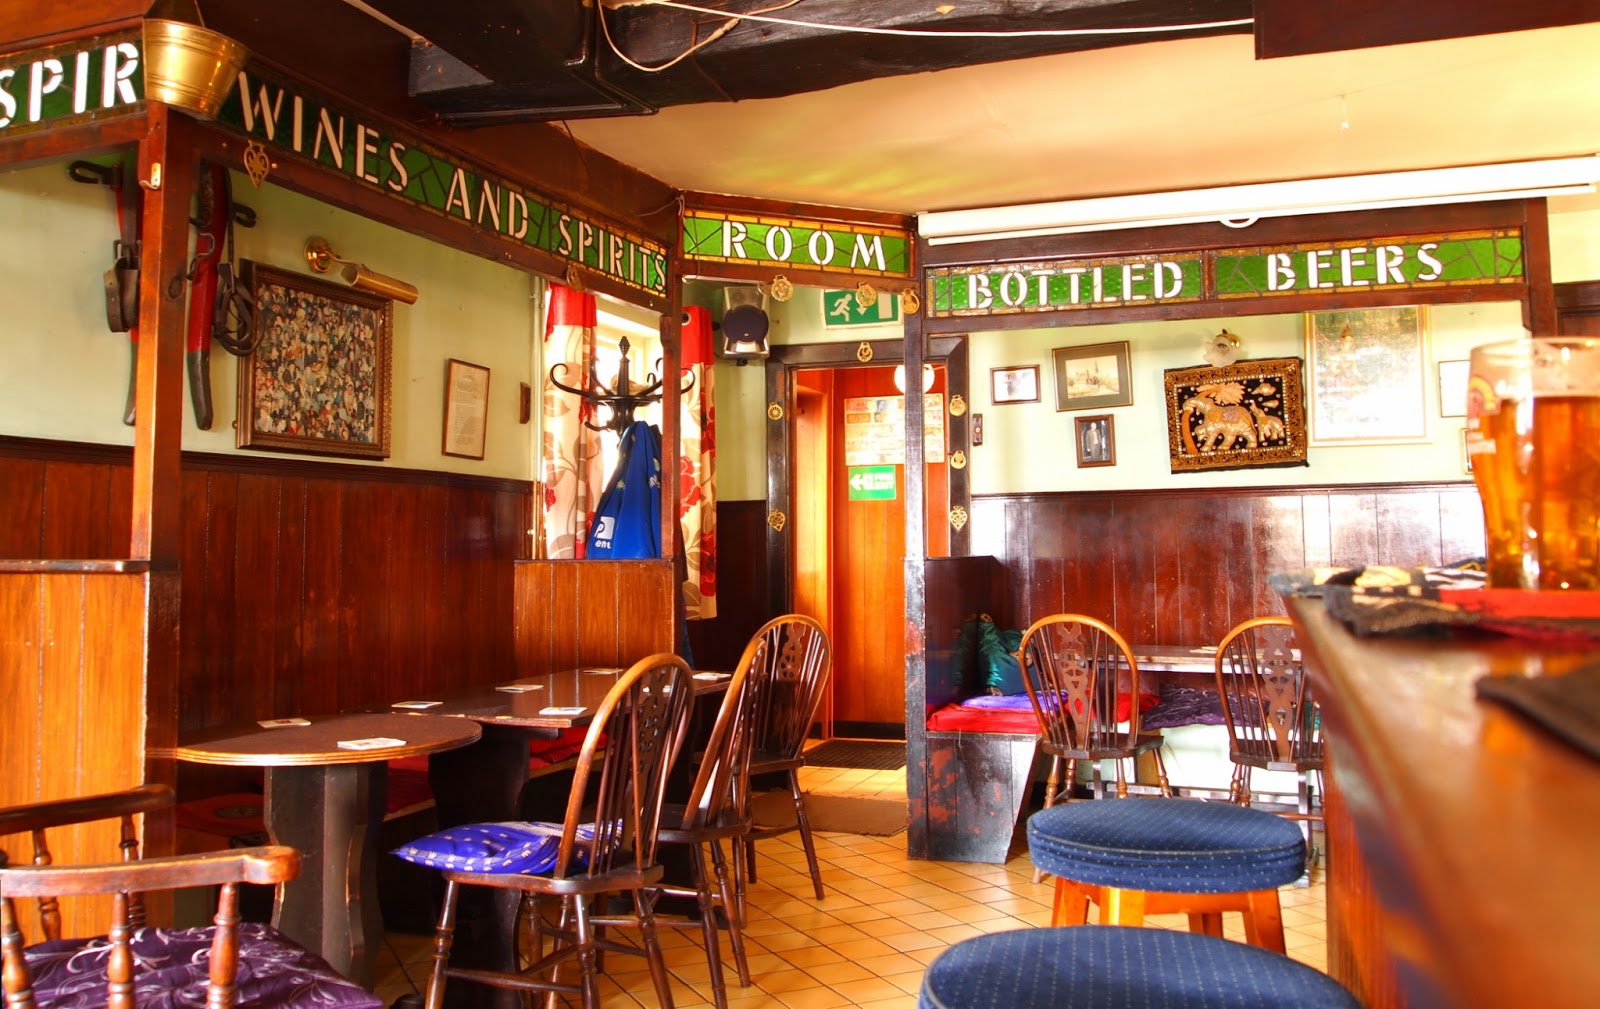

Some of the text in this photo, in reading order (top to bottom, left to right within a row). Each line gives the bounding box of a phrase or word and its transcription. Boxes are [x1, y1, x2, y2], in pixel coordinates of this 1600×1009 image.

[238, 70, 666, 291] WINES AND SPIRITS
[722, 220, 886, 271] ROOM
[968, 243, 1443, 309] BOTTLED BEERS
